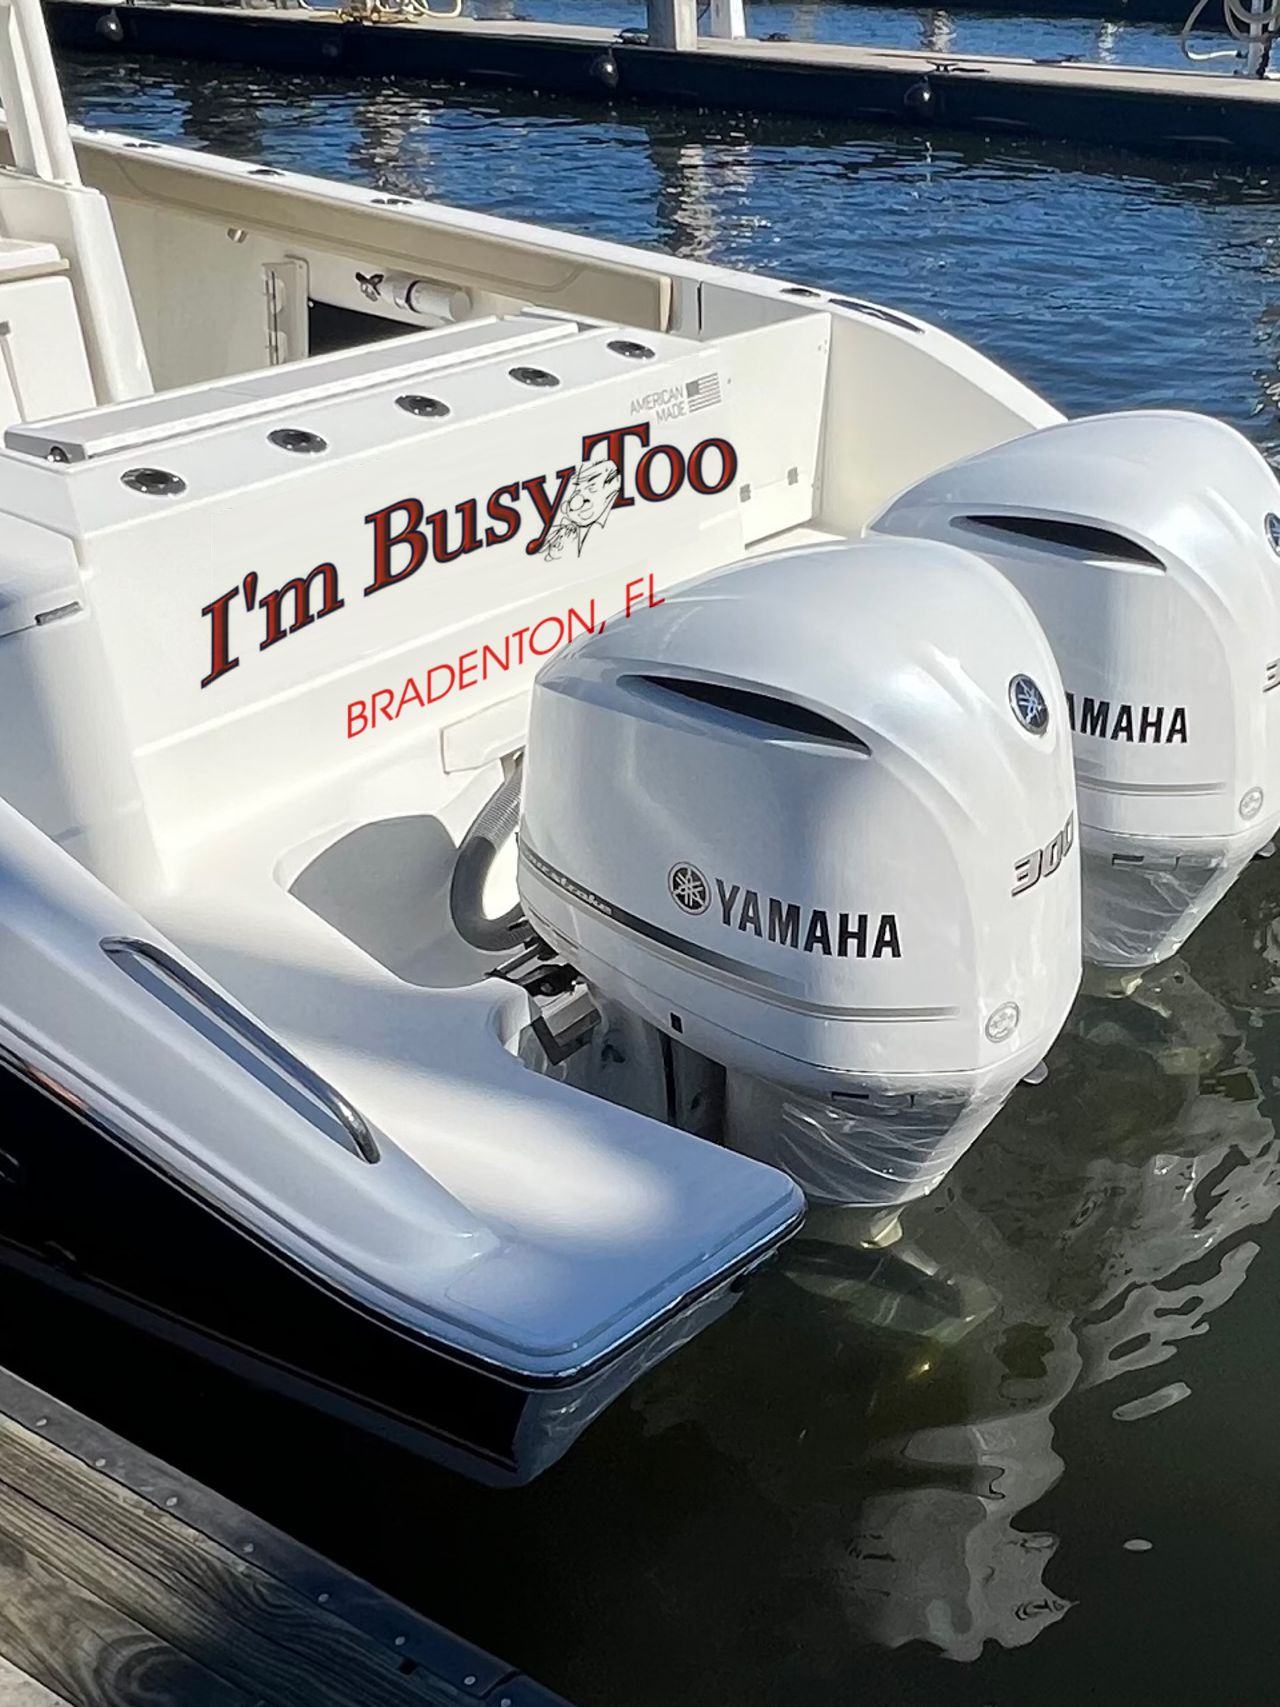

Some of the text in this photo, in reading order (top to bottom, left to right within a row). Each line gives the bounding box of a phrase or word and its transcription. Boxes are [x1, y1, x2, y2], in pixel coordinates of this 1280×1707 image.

[630, 384, 684, 416] AMERICAN
[656, 400, 687, 423] MADE
[200, 421, 738, 689] I'm Busy Too
[347, 573, 665, 739] BRADENTON, FL
[714, 877, 902, 958] YAMAHA
